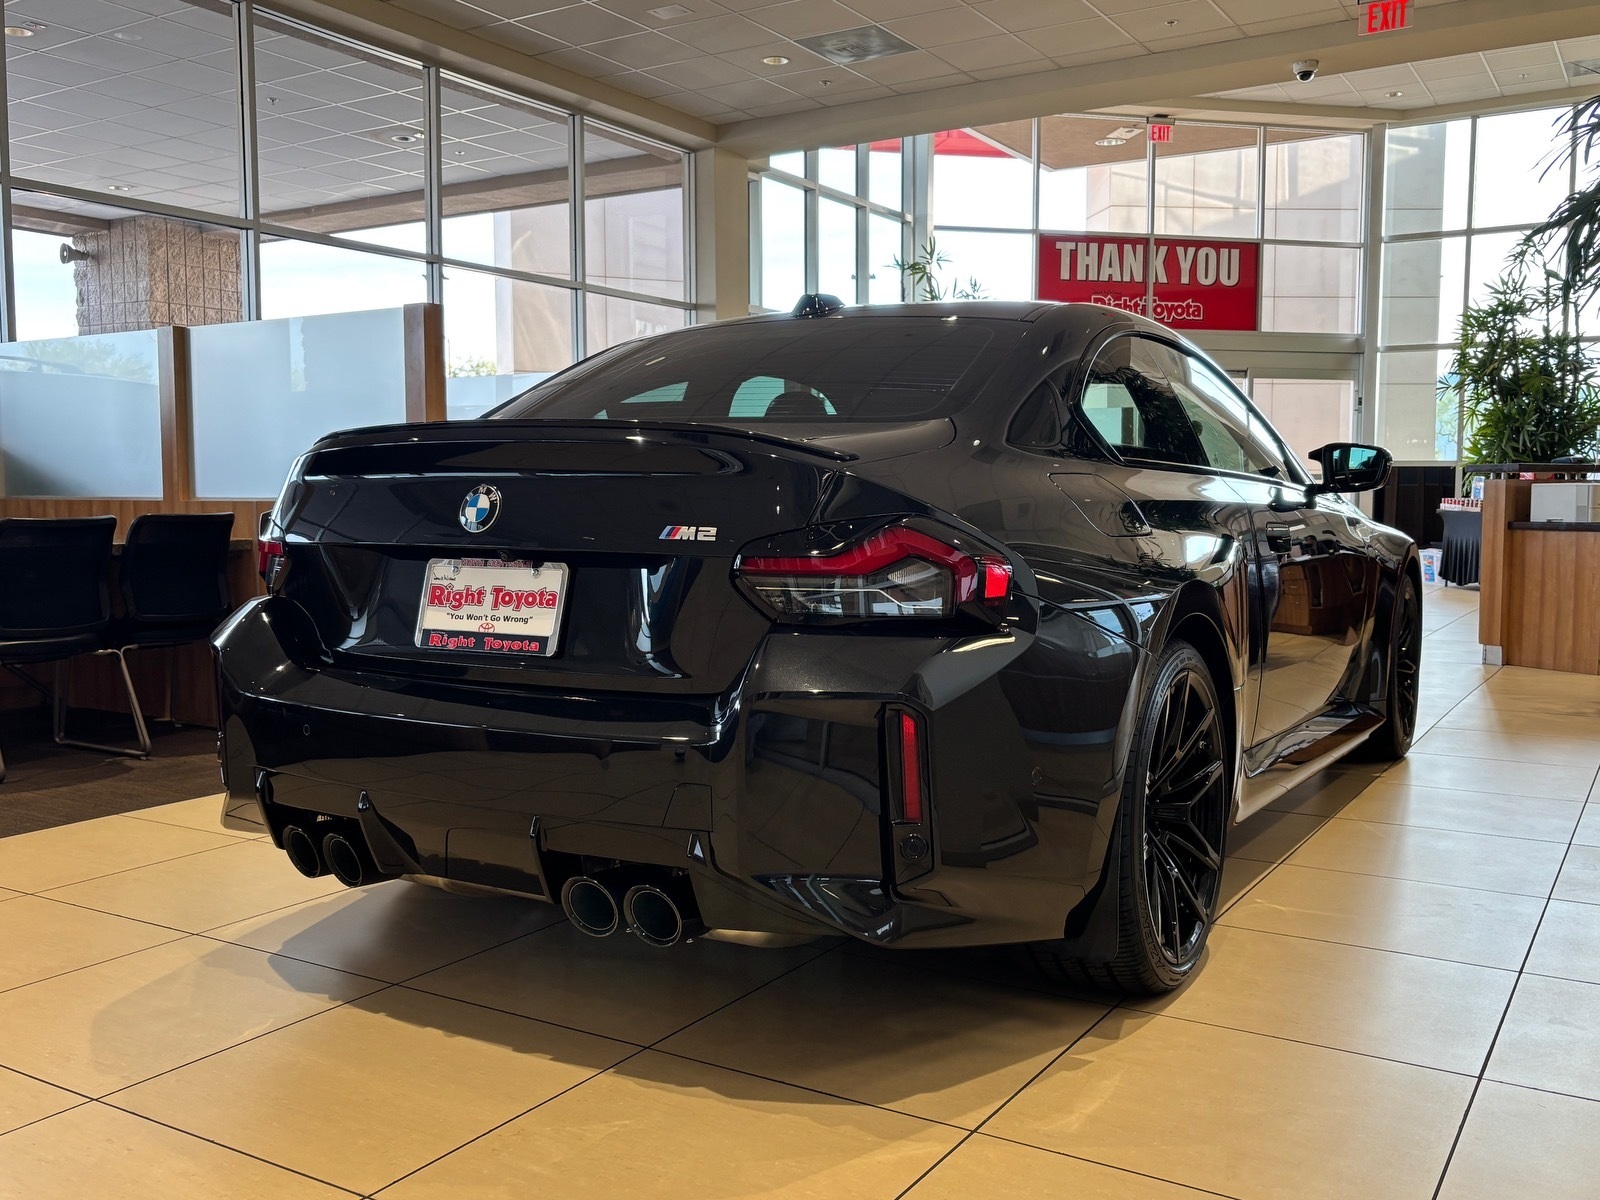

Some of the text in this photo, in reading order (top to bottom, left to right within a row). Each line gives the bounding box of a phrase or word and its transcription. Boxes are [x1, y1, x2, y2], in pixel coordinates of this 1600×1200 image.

[1367, 0, 1409, 33] EXIT
[1152, 125, 1171, 141] EXIT
[1056, 241, 1240, 287] THANK YOU
[674, 525, 718, 541] M2
[427, 583, 559, 612] Right Toyota
[466, 613, 489, 622] Won't
[429, 633, 540, 651] Right Toyota
